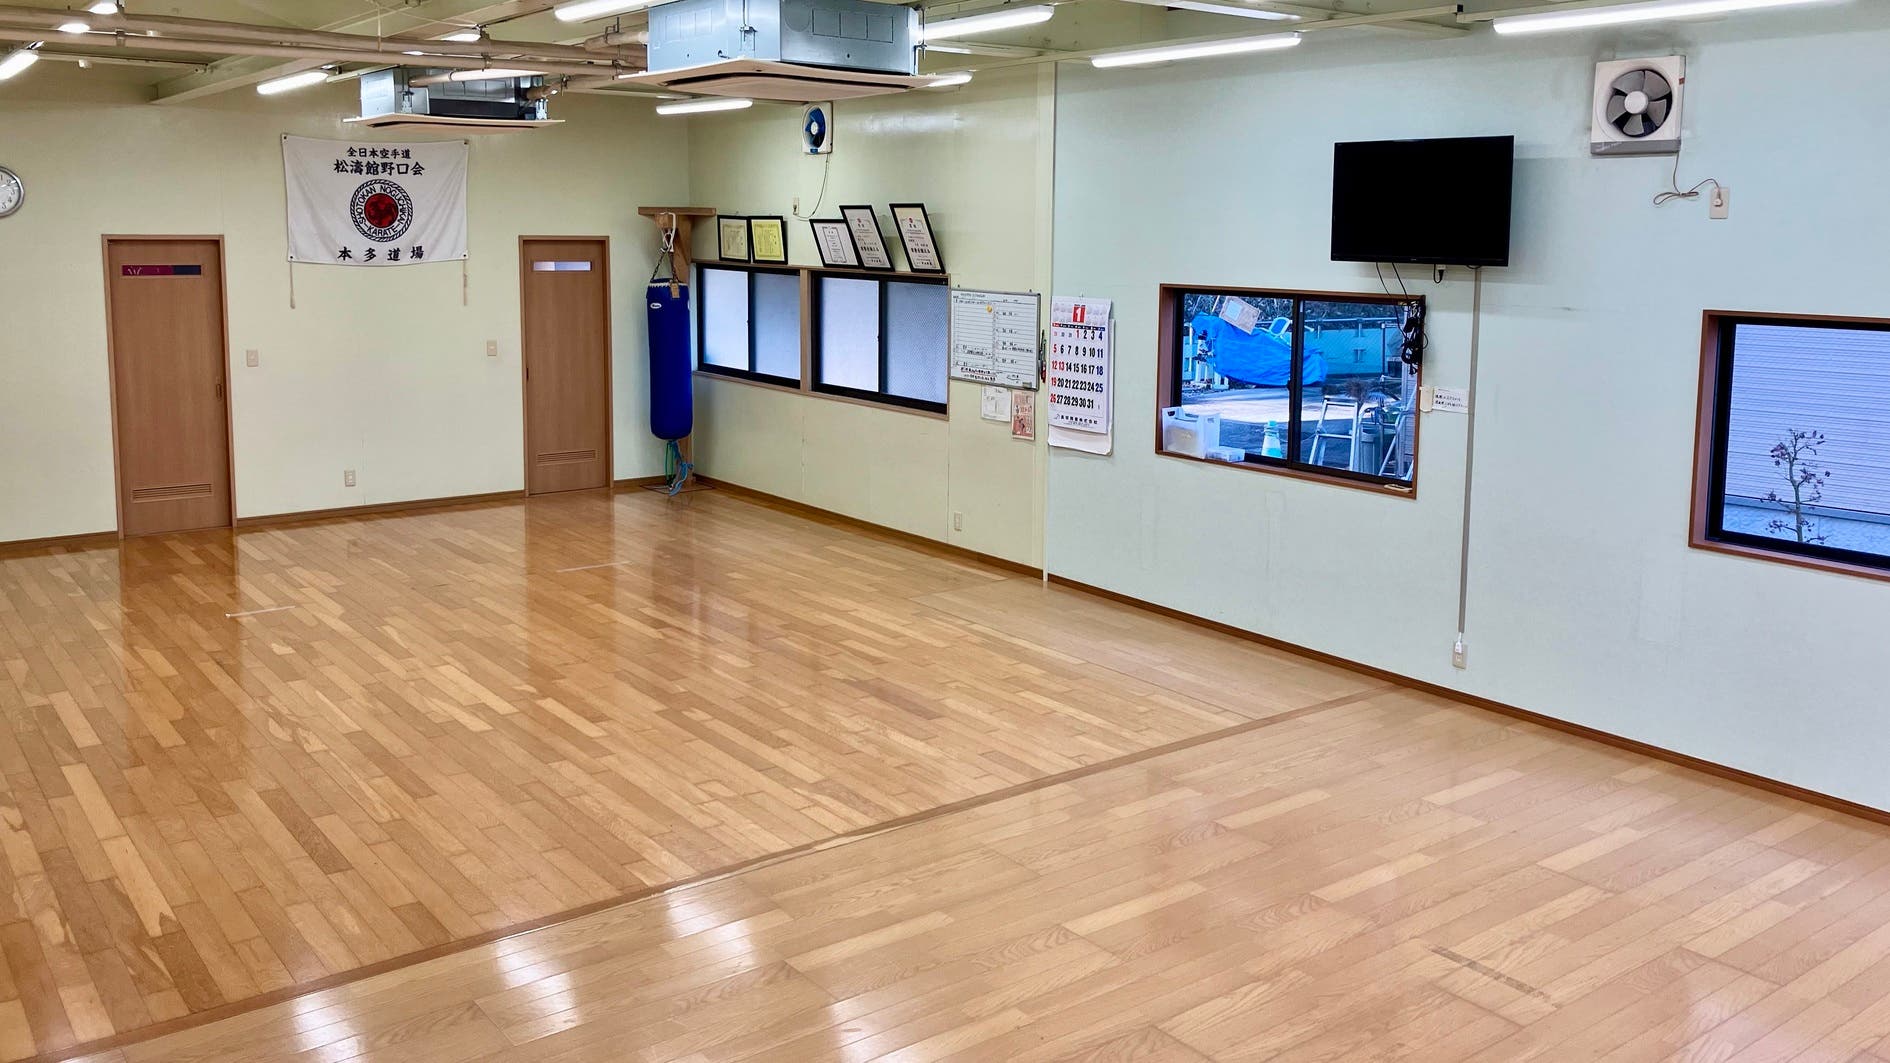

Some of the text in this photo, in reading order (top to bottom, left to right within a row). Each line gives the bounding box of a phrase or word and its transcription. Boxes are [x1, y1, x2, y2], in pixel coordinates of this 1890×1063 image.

[347, 147, 411, 159] 全日本空手道
[333, 159, 425, 176] 松濤館野口会
[355, 185, 408, 225] SHOTOKAN NOGUCHIKAI
[337, 246, 424, 262] 本多道場
[1075, 307, 1082, 322] 1
[1076, 330, 1079, 339] 1
[1084, 330, 1087, 339] 2
[1091, 330, 1095, 340] 3
[1098, 332, 1103, 341] 4
[1054, 344, 1103, 358] 5 6 7 8 9 10 11
[1052, 360, 1103, 375] 12 13 14 15 16 17 18
[1051, 377, 1103, 393] 19 20 21 22 23 24 25
[1050, 394, 1056, 403] 26
[1057, 394, 1063, 404] 27
[1064, 396, 1070, 406] 28
[1071, 396, 1078, 407] 29
[1079, 398, 1086, 408] 30
[1087, 399, 1094, 409] 31
